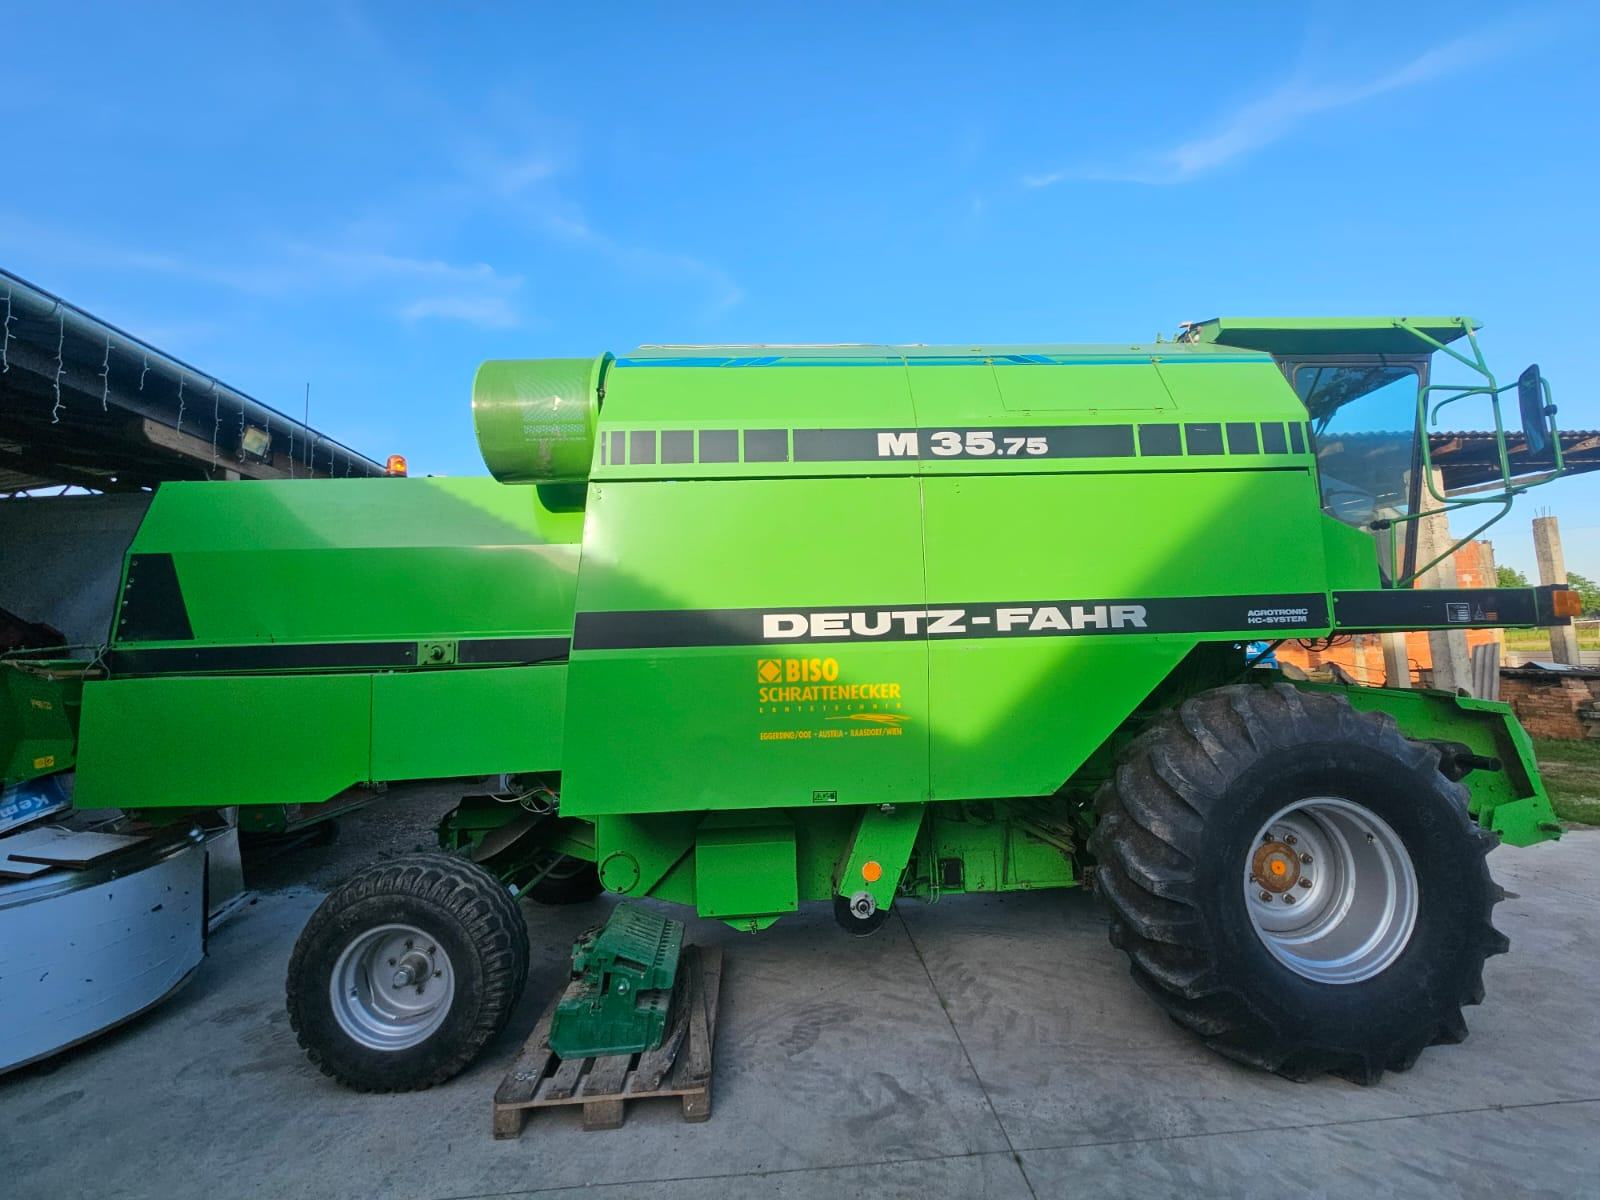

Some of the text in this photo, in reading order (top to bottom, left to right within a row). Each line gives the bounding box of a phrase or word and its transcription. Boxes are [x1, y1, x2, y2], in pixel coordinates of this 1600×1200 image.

[877, 431, 1049, 457] M 35.75
[762, 604, 1148, 639] DEUTZ-FAHR
[1247, 608, 1309, 617] AGROTRONIC
[785, 658, 839, 683] BISO
[758, 683, 902, 703] SCHRATTENECKER
